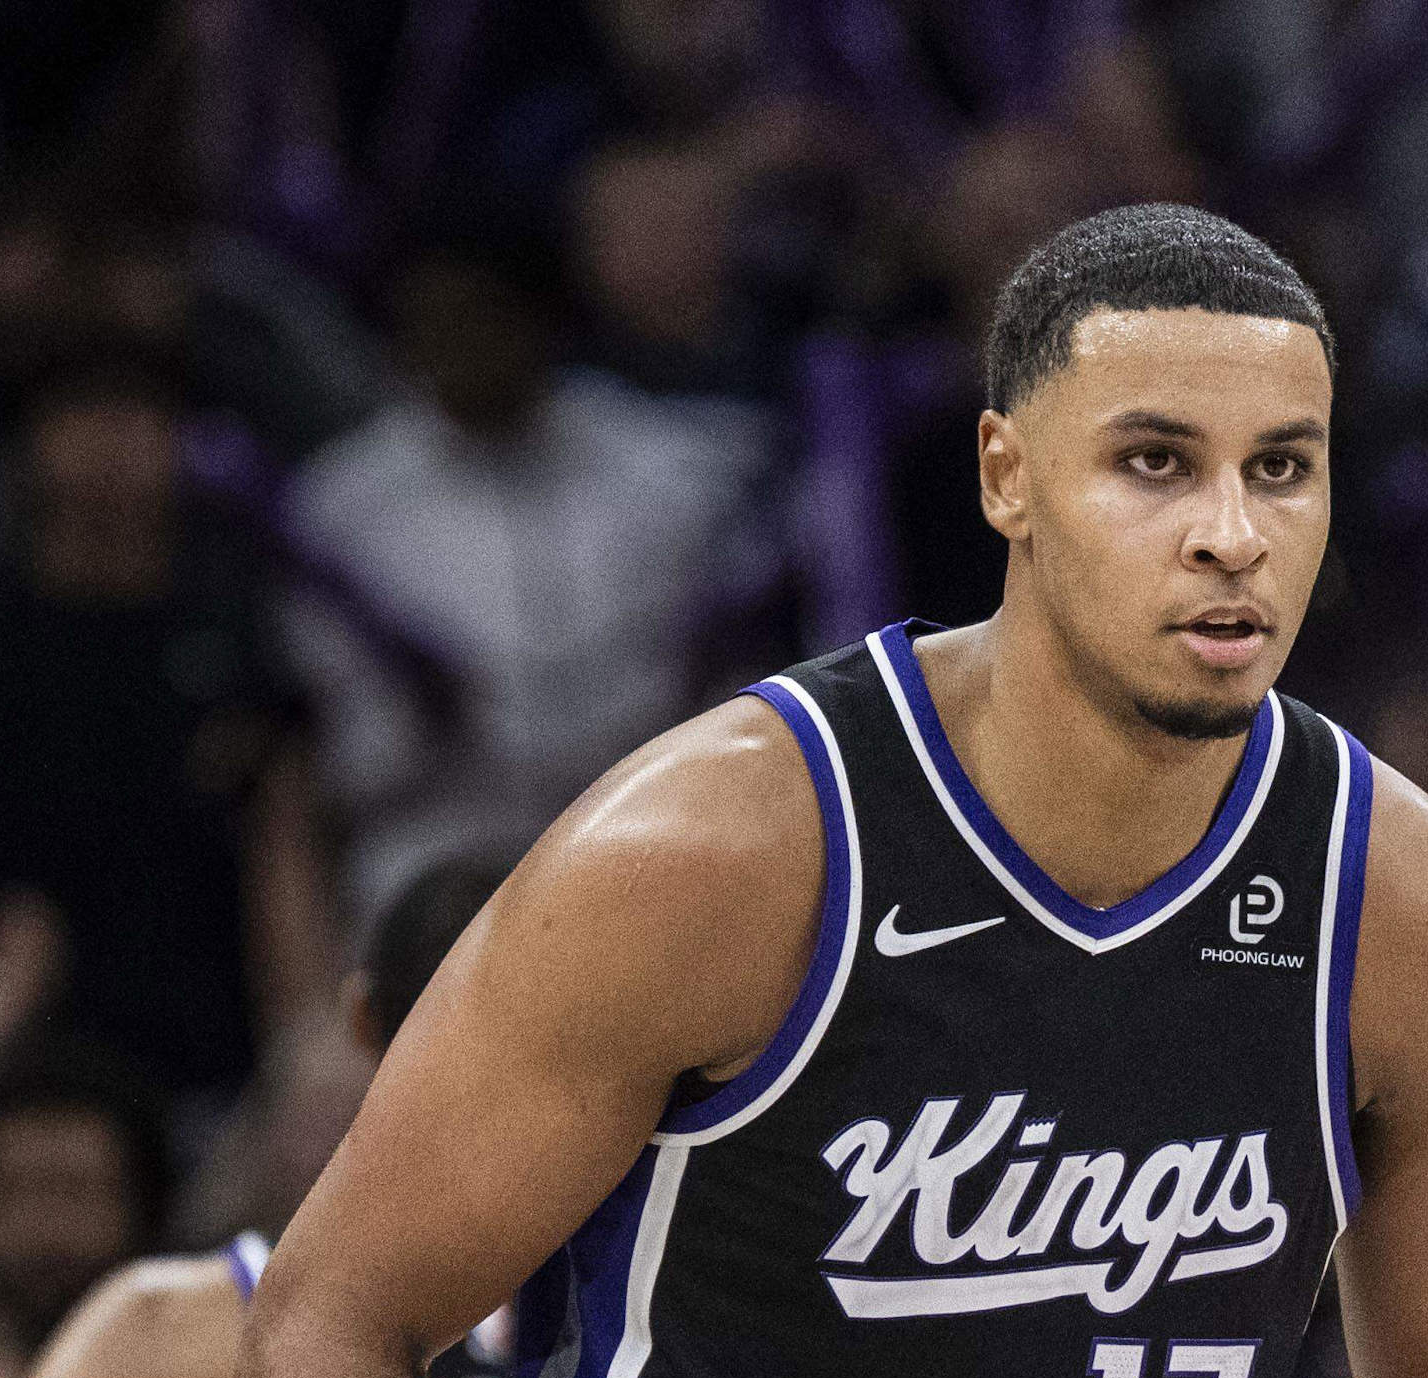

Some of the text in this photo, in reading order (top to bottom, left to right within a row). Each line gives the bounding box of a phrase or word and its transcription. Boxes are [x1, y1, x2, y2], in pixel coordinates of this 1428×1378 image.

[1200, 947, 1305, 969] PHOONG LAW
[816, 1089, 1289, 1318] Kings
